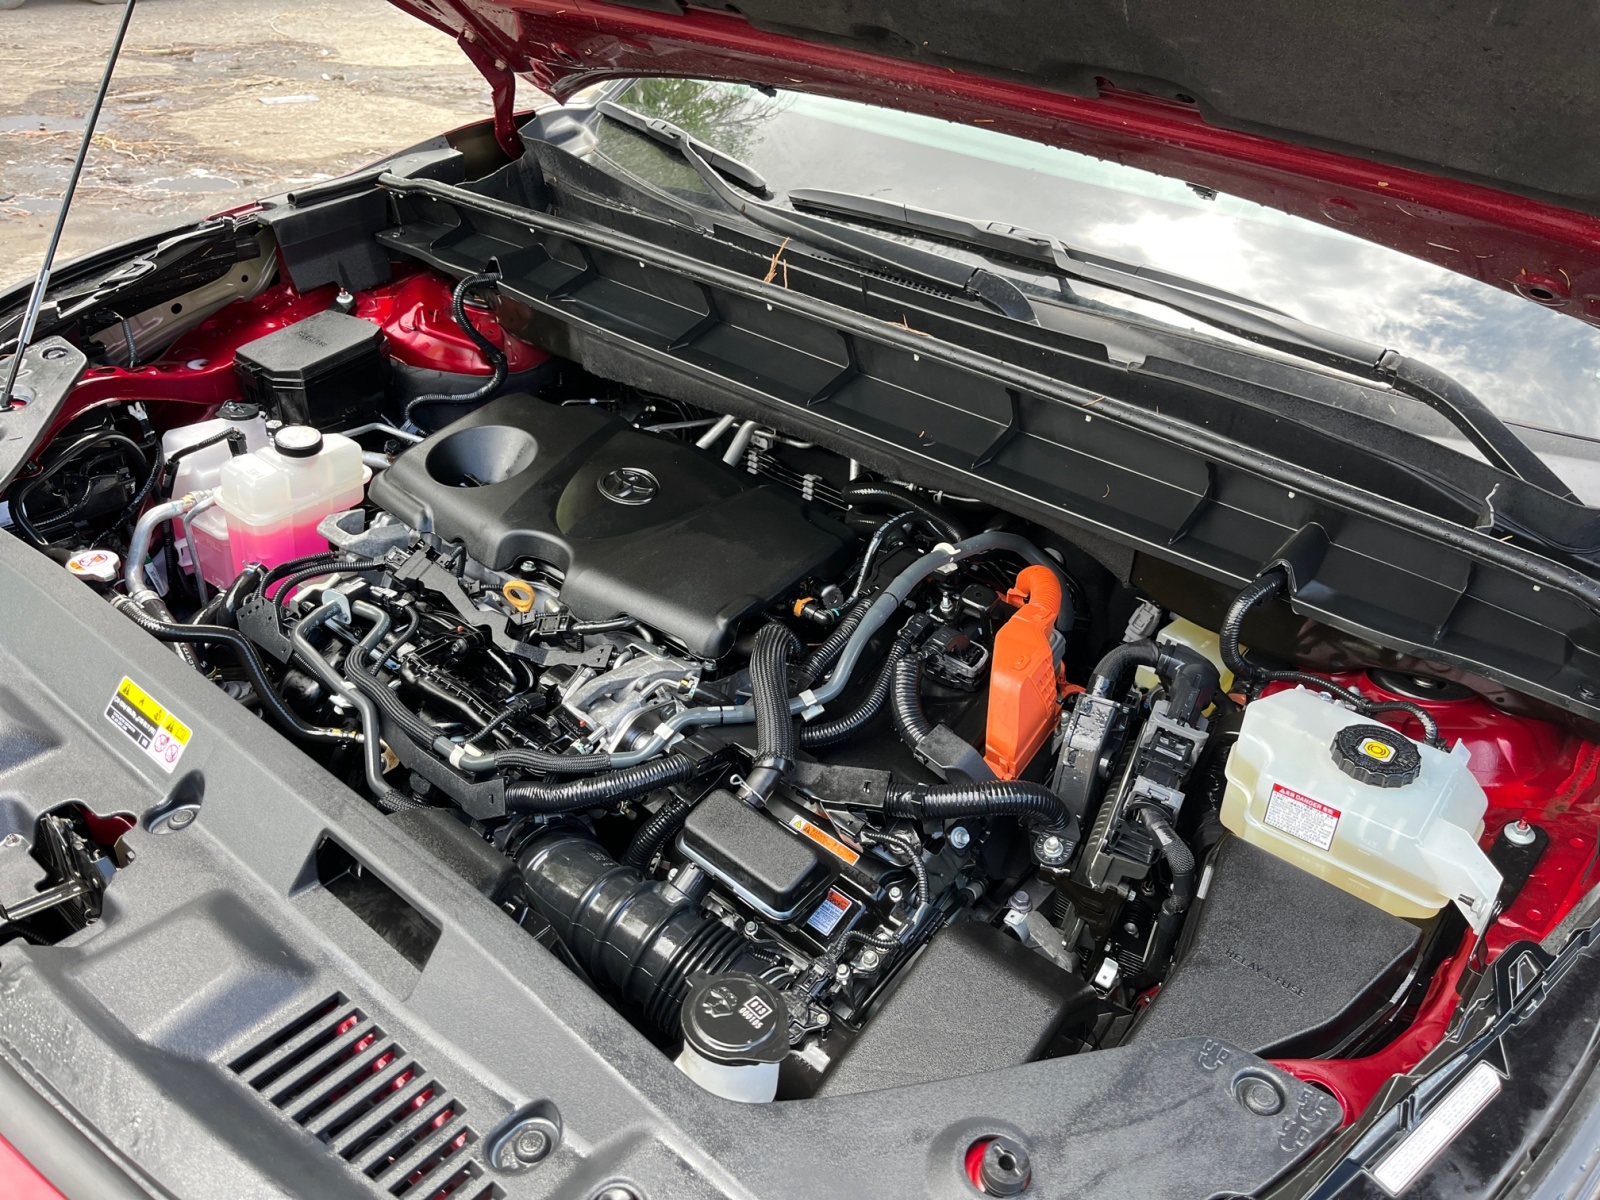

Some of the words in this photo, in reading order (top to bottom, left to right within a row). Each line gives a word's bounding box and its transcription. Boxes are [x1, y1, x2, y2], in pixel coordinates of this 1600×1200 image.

[1295, 793, 1322, 810] DANGER
[1225, 948, 1264, 973] RELAY
[1274, 976, 1306, 999] FUSE
[738, 1007, 763, 1029] 000105
